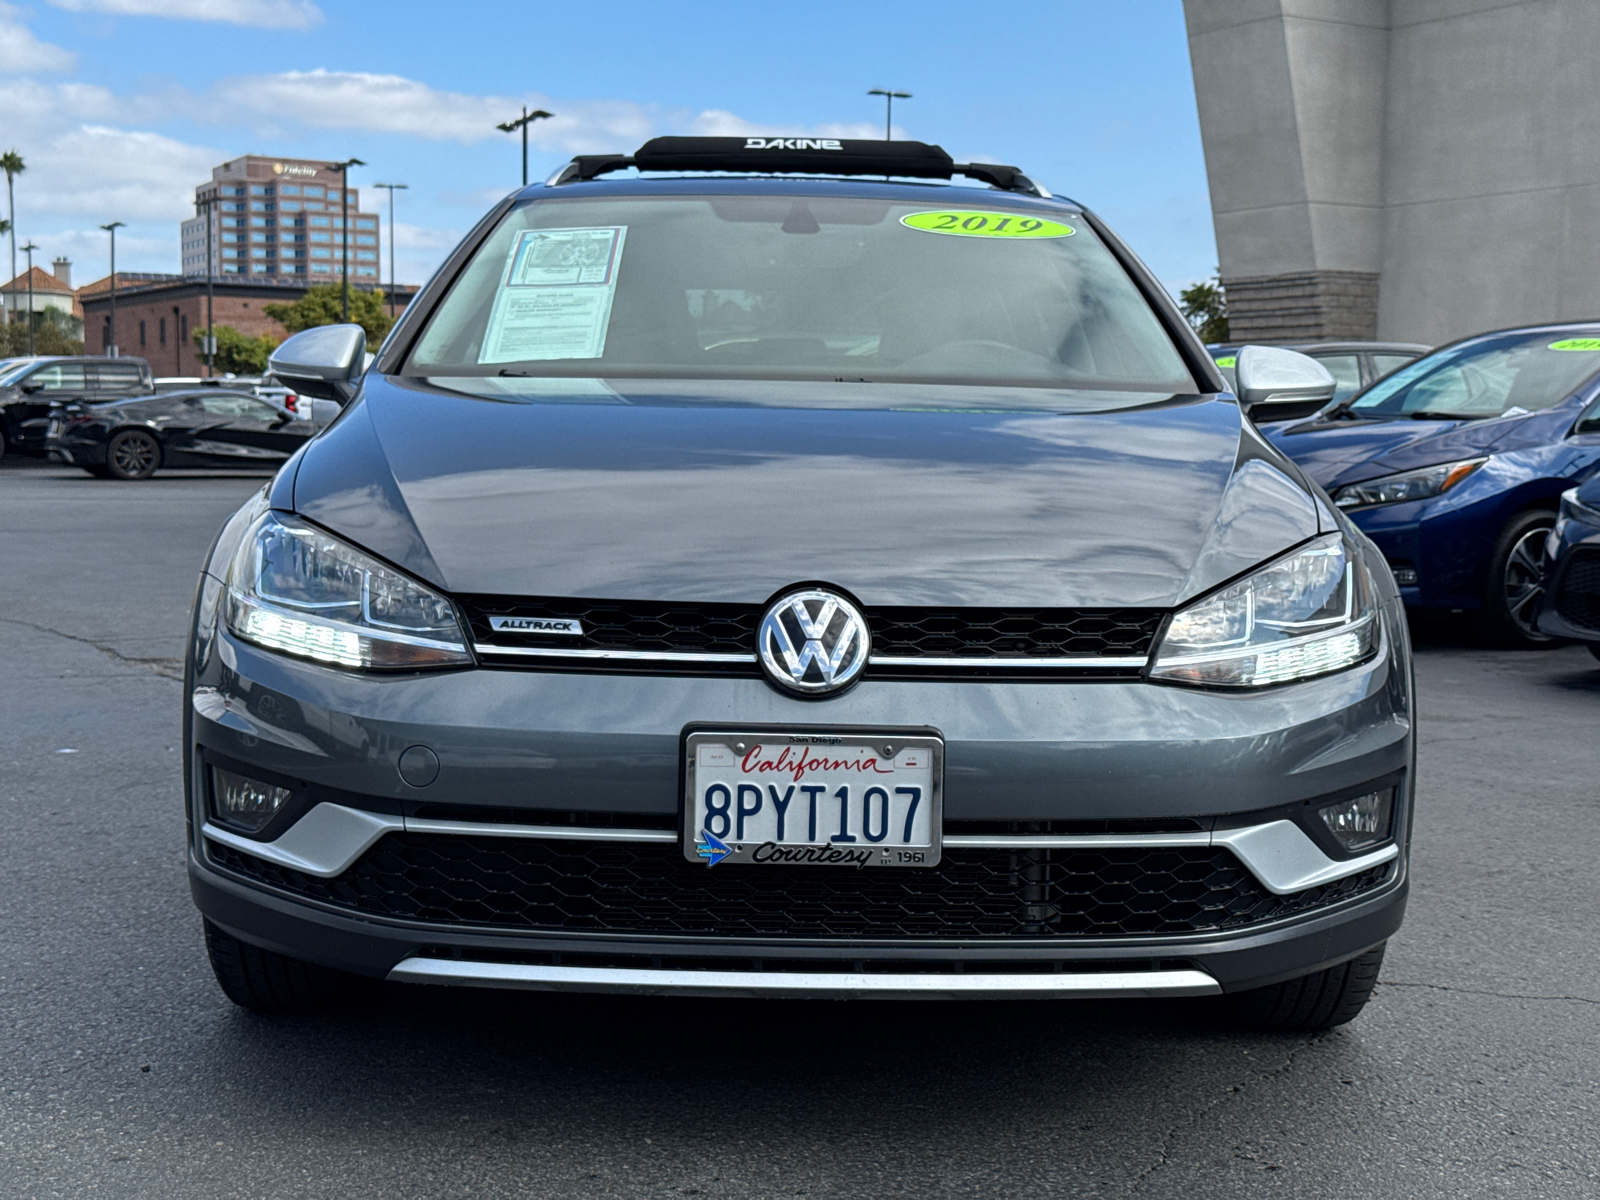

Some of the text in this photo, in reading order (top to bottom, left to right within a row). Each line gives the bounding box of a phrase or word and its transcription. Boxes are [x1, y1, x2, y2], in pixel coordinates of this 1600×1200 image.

[743, 138, 844, 151] DAKINE
[931, 214, 1044, 234] 2019
[498, 619, 573, 632] ALLTRACK
[812, 736, 842, 745] Diego
[741, 745, 894, 782] California
[704, 783, 922, 843] 8PYT107
[752, 841, 874, 869] Courtesy
[897, 851, 925, 863] 1961
